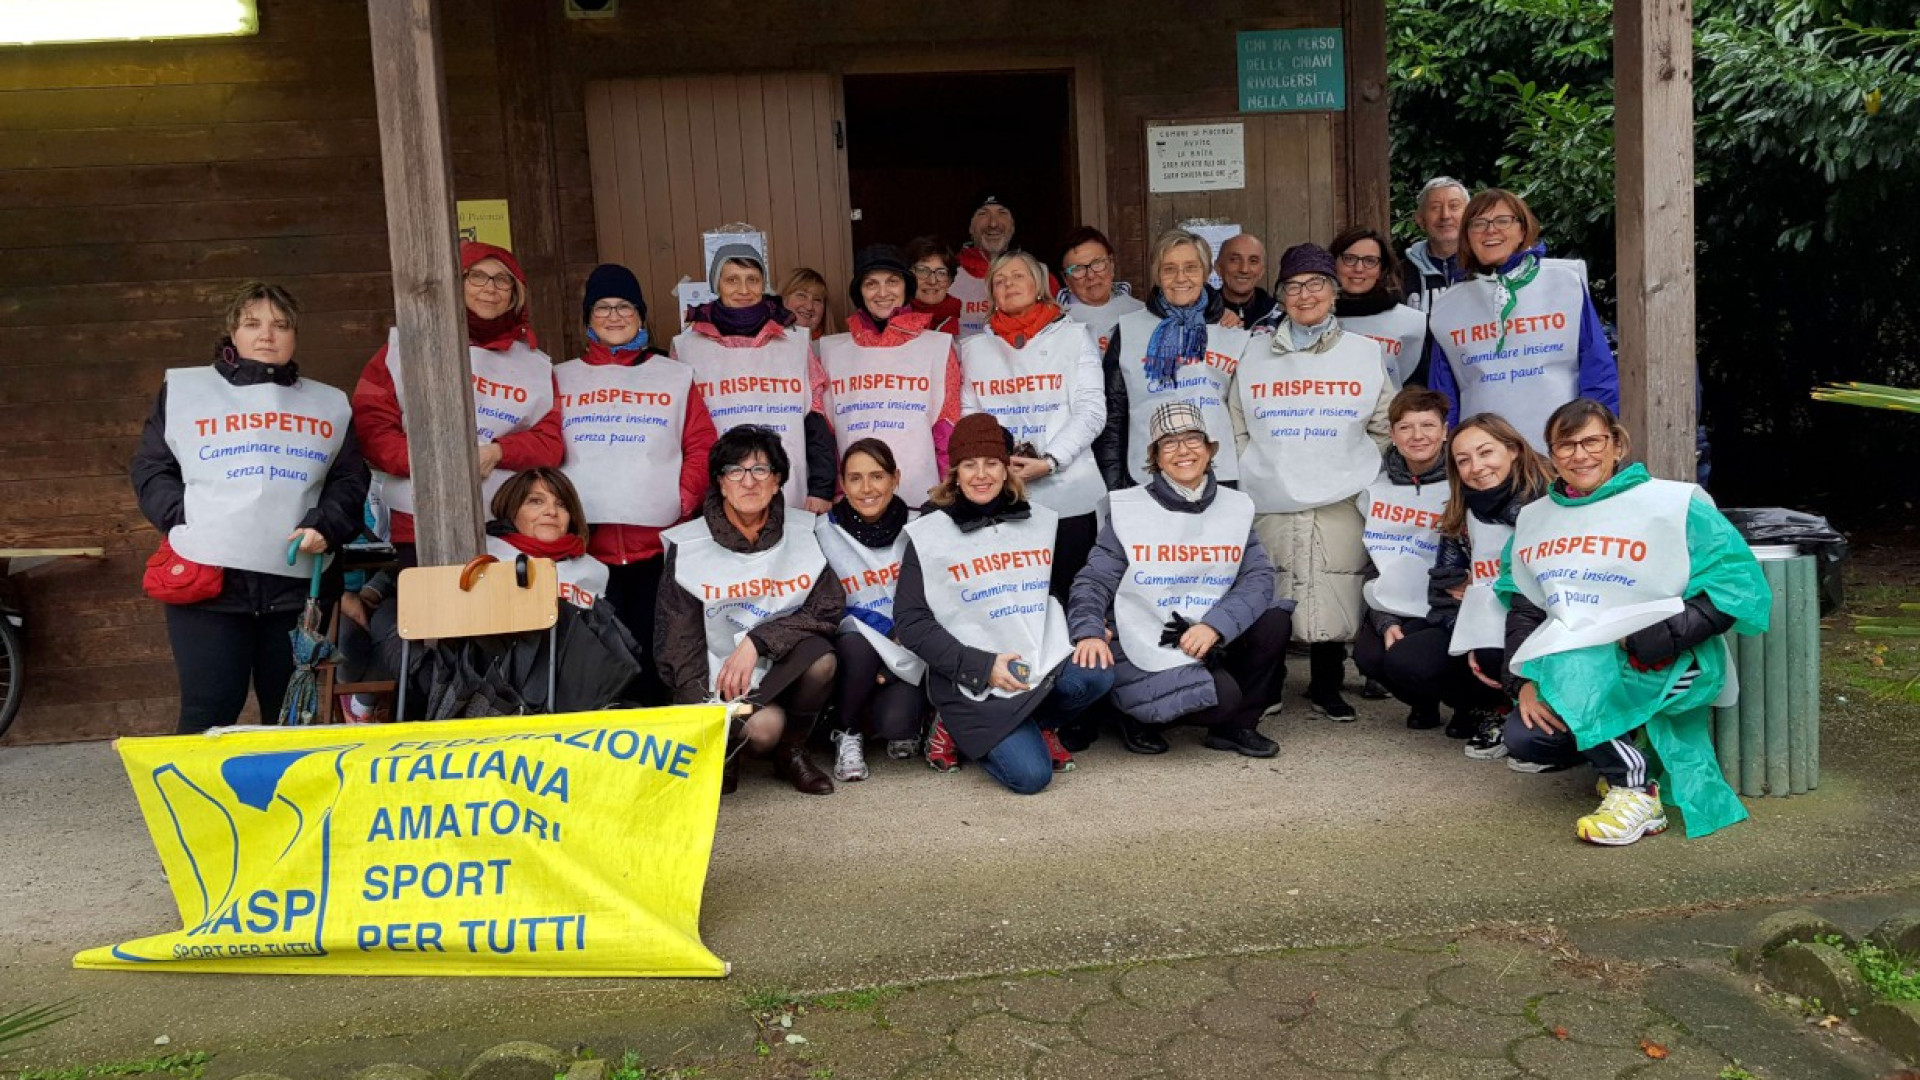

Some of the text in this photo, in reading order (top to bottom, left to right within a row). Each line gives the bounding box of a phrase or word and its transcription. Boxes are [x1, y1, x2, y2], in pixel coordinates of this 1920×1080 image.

[1244, 36, 1335, 52] CHI HA PERSO
[1246, 52, 1332, 71] DELLE CHIAVI
[1247, 71, 1317, 89] RIVOLGERSI
[1247, 89, 1335, 109] NELLA BAITA
[1450, 312, 1566, 347] TI RISPETTO
[1460, 342, 1565, 367] Camminare insieme
[832, 373, 930, 395] TI RISPETTO
[972, 373, 1063, 396] TI RISPETTO
[1510, 366, 1544, 383] paura
[472, 374, 528, 403] ETTO
[697, 375, 802, 398] TI RISPETTO
[1251, 379, 1362, 399] TI RISPETTO
[558, 388, 671, 407] TI RISPETTO
[835, 398, 927, 415] Camminare insieme
[478, 405, 522, 425] insieme
[710, 403, 803, 418] amminare insieme
[984, 403, 1030, 415] mminare
[1254, 406, 1359, 420] Camminare insieme
[195, 412, 334, 439] TI RISPETTO
[625, 412, 669, 428] insieme
[847, 418, 905, 433] senza paura
[573, 432, 646, 445] senza paura
[1270, 427, 1338, 440] senza paura
[199, 440, 328, 464] Camminare insieme
[226, 465, 308, 482] senza paura
[1370, 501, 1444, 531] RISPET
[1363, 529, 1413, 543] mminare
[1415, 535, 1438, 552] insie
[1518, 535, 1647, 564] TI RISPETTO
[1132, 544, 1242, 562] TI RISPETTO
[948, 548, 1051, 582] TI RISPETTO
[840, 575, 861, 595] TI
[1021, 579, 1050, 593] insiem
[1134, 571, 1235, 586] Camminare insiem
[1535, 567, 1637, 587] minare insieme
[702, 583, 721, 600] TI
[1563, 590, 1600, 607] paura
[989, 602, 1045, 620] senza aura
[388, 728, 698, 779] FEDERAZIONE
[369, 750, 570, 803] ITALIANA
[367, 799, 561, 843] AMATORI
[362, 859, 512, 902] SPORT
[187, 889, 316, 936] ASP
[357, 914, 586, 954] PER TUTTI
[172, 941, 315, 960] SPORT PER TUTTI
